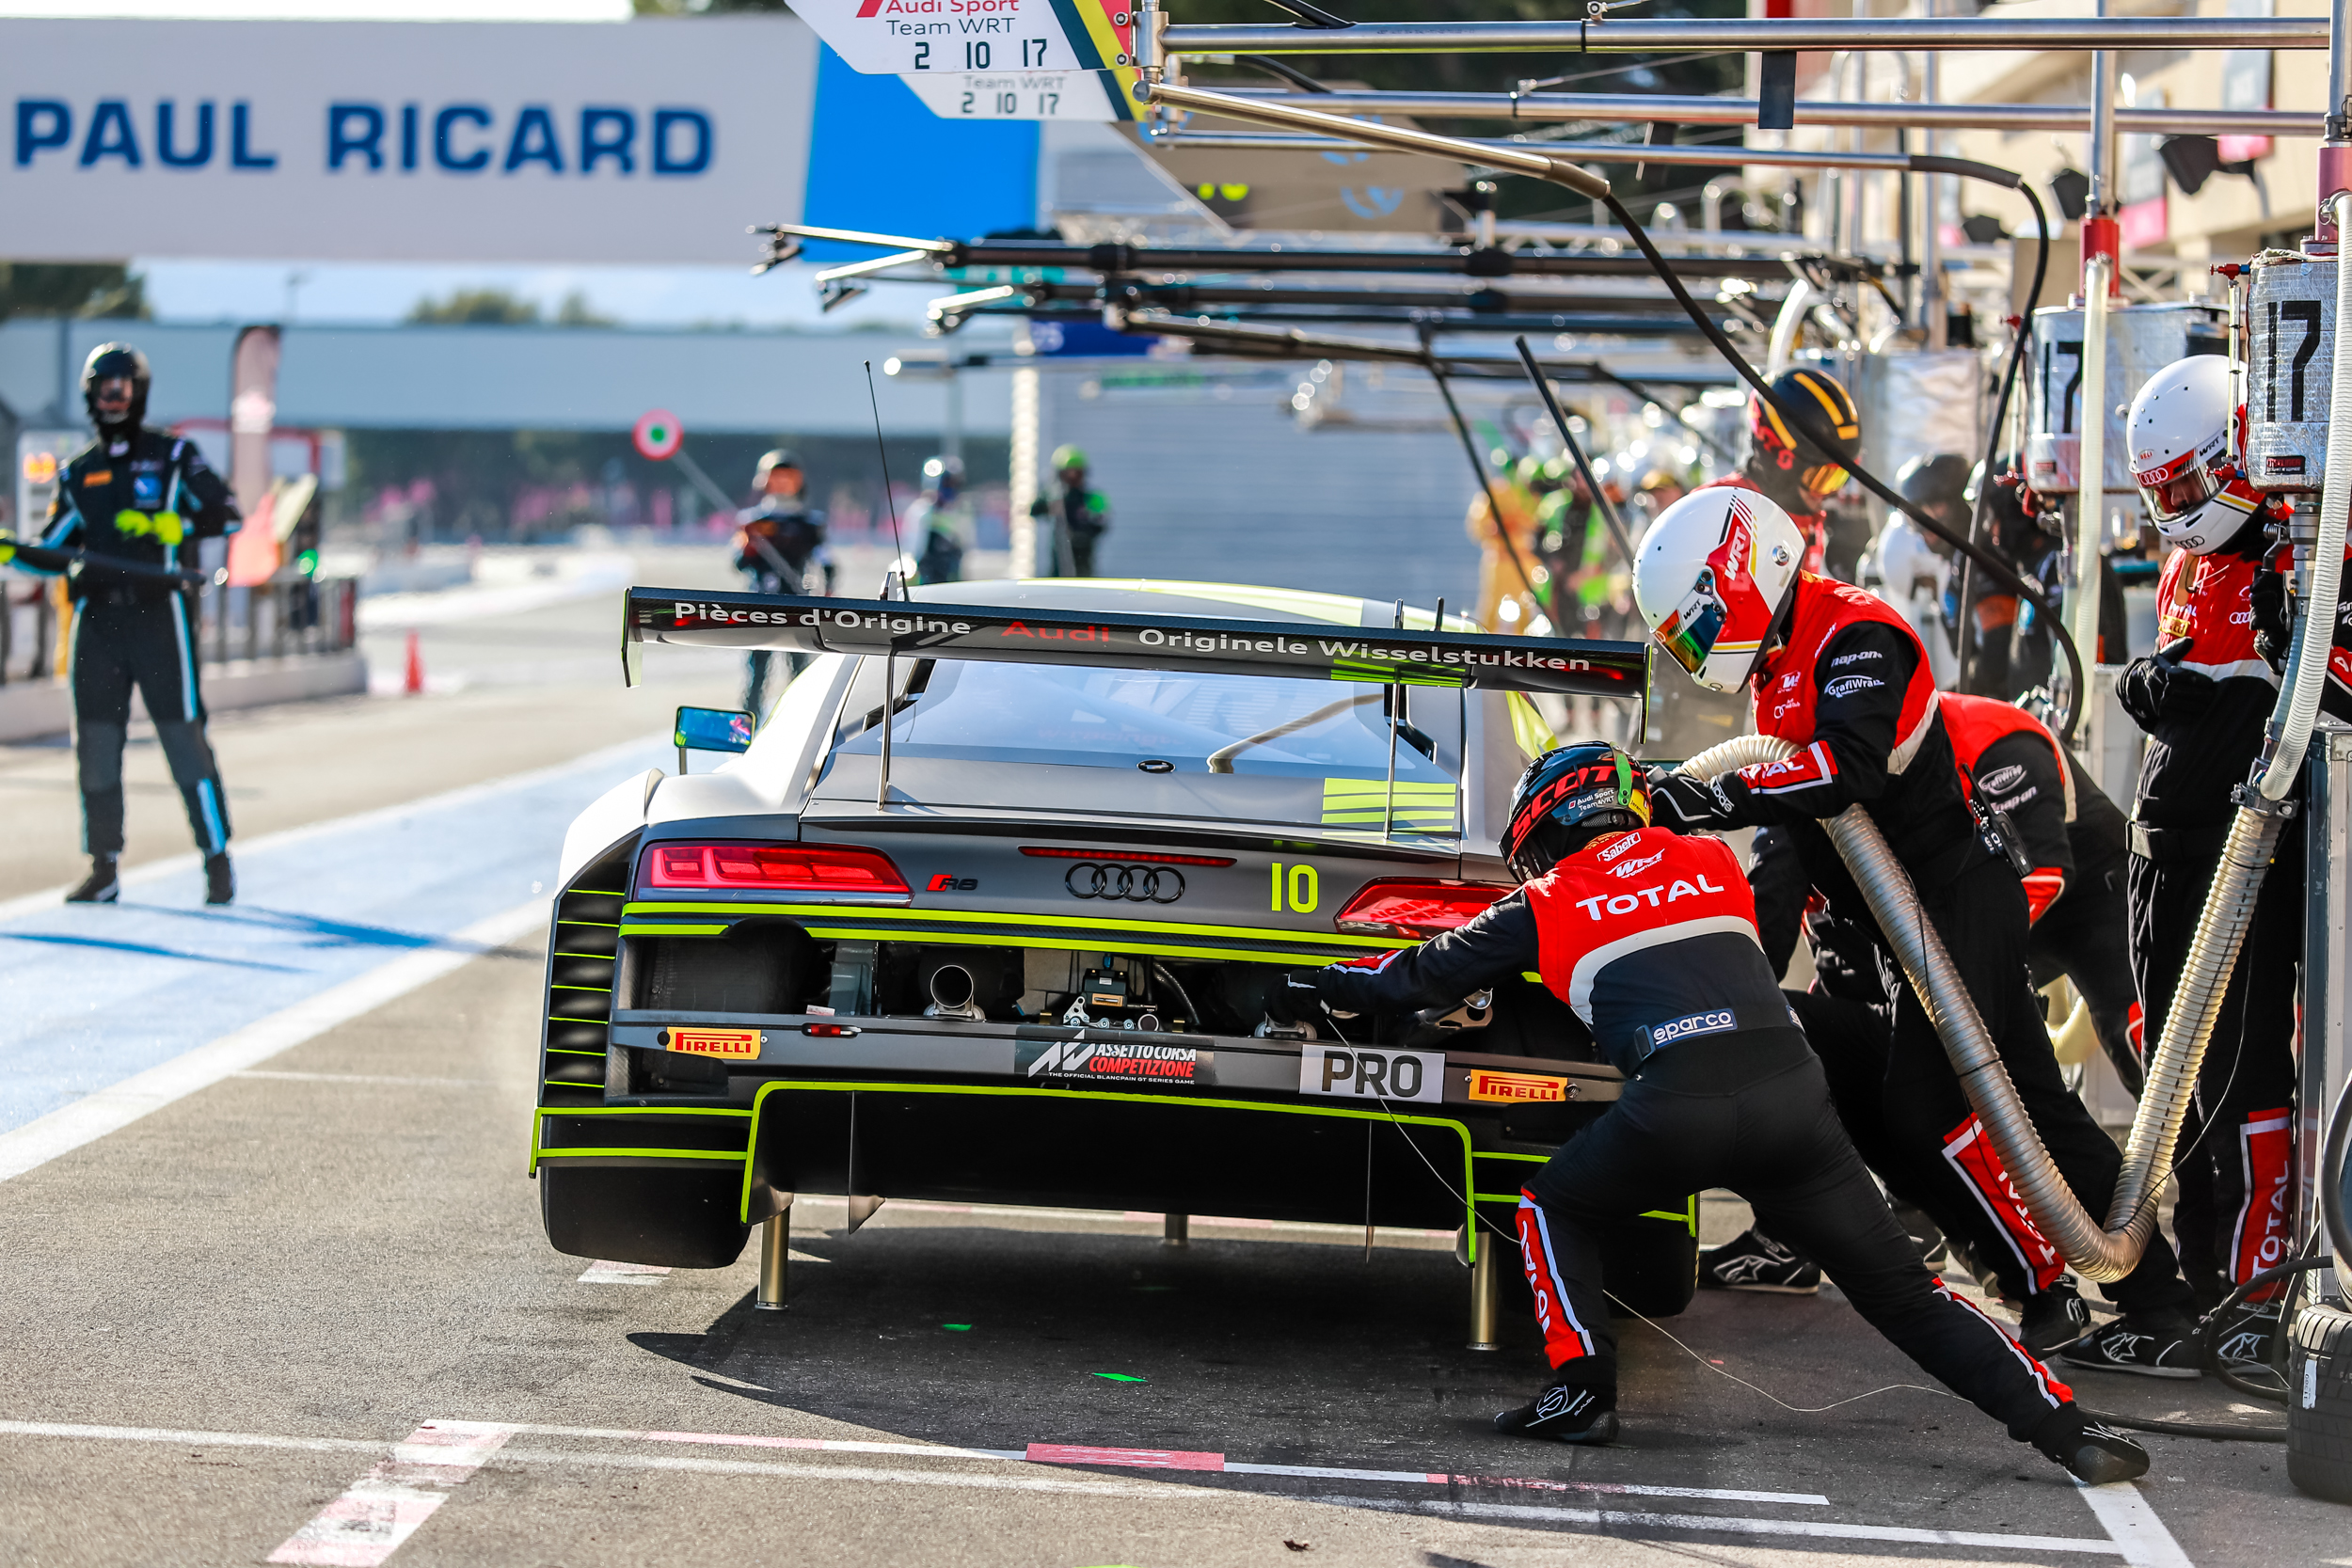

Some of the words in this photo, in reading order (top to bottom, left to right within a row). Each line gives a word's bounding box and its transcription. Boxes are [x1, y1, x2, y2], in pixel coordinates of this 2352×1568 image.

[885, 0, 942, 13] Audi
[950, 0, 1020, 16] Sport
[886, 20, 951, 36] Team
[958, 18, 1016, 34] WRT
[914, 41, 930, 70] 2
[966, 41, 991, 70] 10
[1023, 38, 1047, 68] 17
[963, 75, 1016, 89] Team
[1020, 76, 1067, 90] WRT
[961, 91, 975, 114] 2
[996, 93, 1017, 114] 10
[1039, 93, 1060, 115] 17
[15, 99, 278, 168] PAUL
[326, 103, 717, 176] RICARD
[2266, 300, 2321, 421] 17
[2043, 341, 2084, 434] 17
[2199, 436, 2219, 457] WRT
[1724, 525, 1747, 581] WRT
[1683, 598, 1702, 621] WRT
[675, 602, 787, 626] Pièces
[800, 609, 971, 635] d'Origine
[1001, 621, 1109, 642] Audi
[1138, 628, 1309, 655] Originele
[1318, 640, 1590, 672] Wisselstukken
[1577, 794, 1594, 806] Audi
[1595, 789, 1614, 800] Sport
[1579, 801, 1598, 811] Team
[1597, 795, 1614, 805] WRT
[1602, 833, 1636, 862] Sabelt
[939, 878, 978, 892] R8
[1270, 862, 1319, 913] 10
[1576, 874, 1724, 921] TOTAL
[1653, 1011, 1732, 1041] sparco
[675, 1032, 752, 1053] PIRELLI
[1095, 1043, 1154, 1058] ASSETTO
[1154, 1046, 1197, 1062] CORSA
[1089, 1057, 1196, 1078] COMPETIZIONE
[1322, 1051, 1422, 1098] PRO
[1478, 1075, 1560, 1101] PIRELLI
[2251, 1161, 2290, 1279] TOTAL
